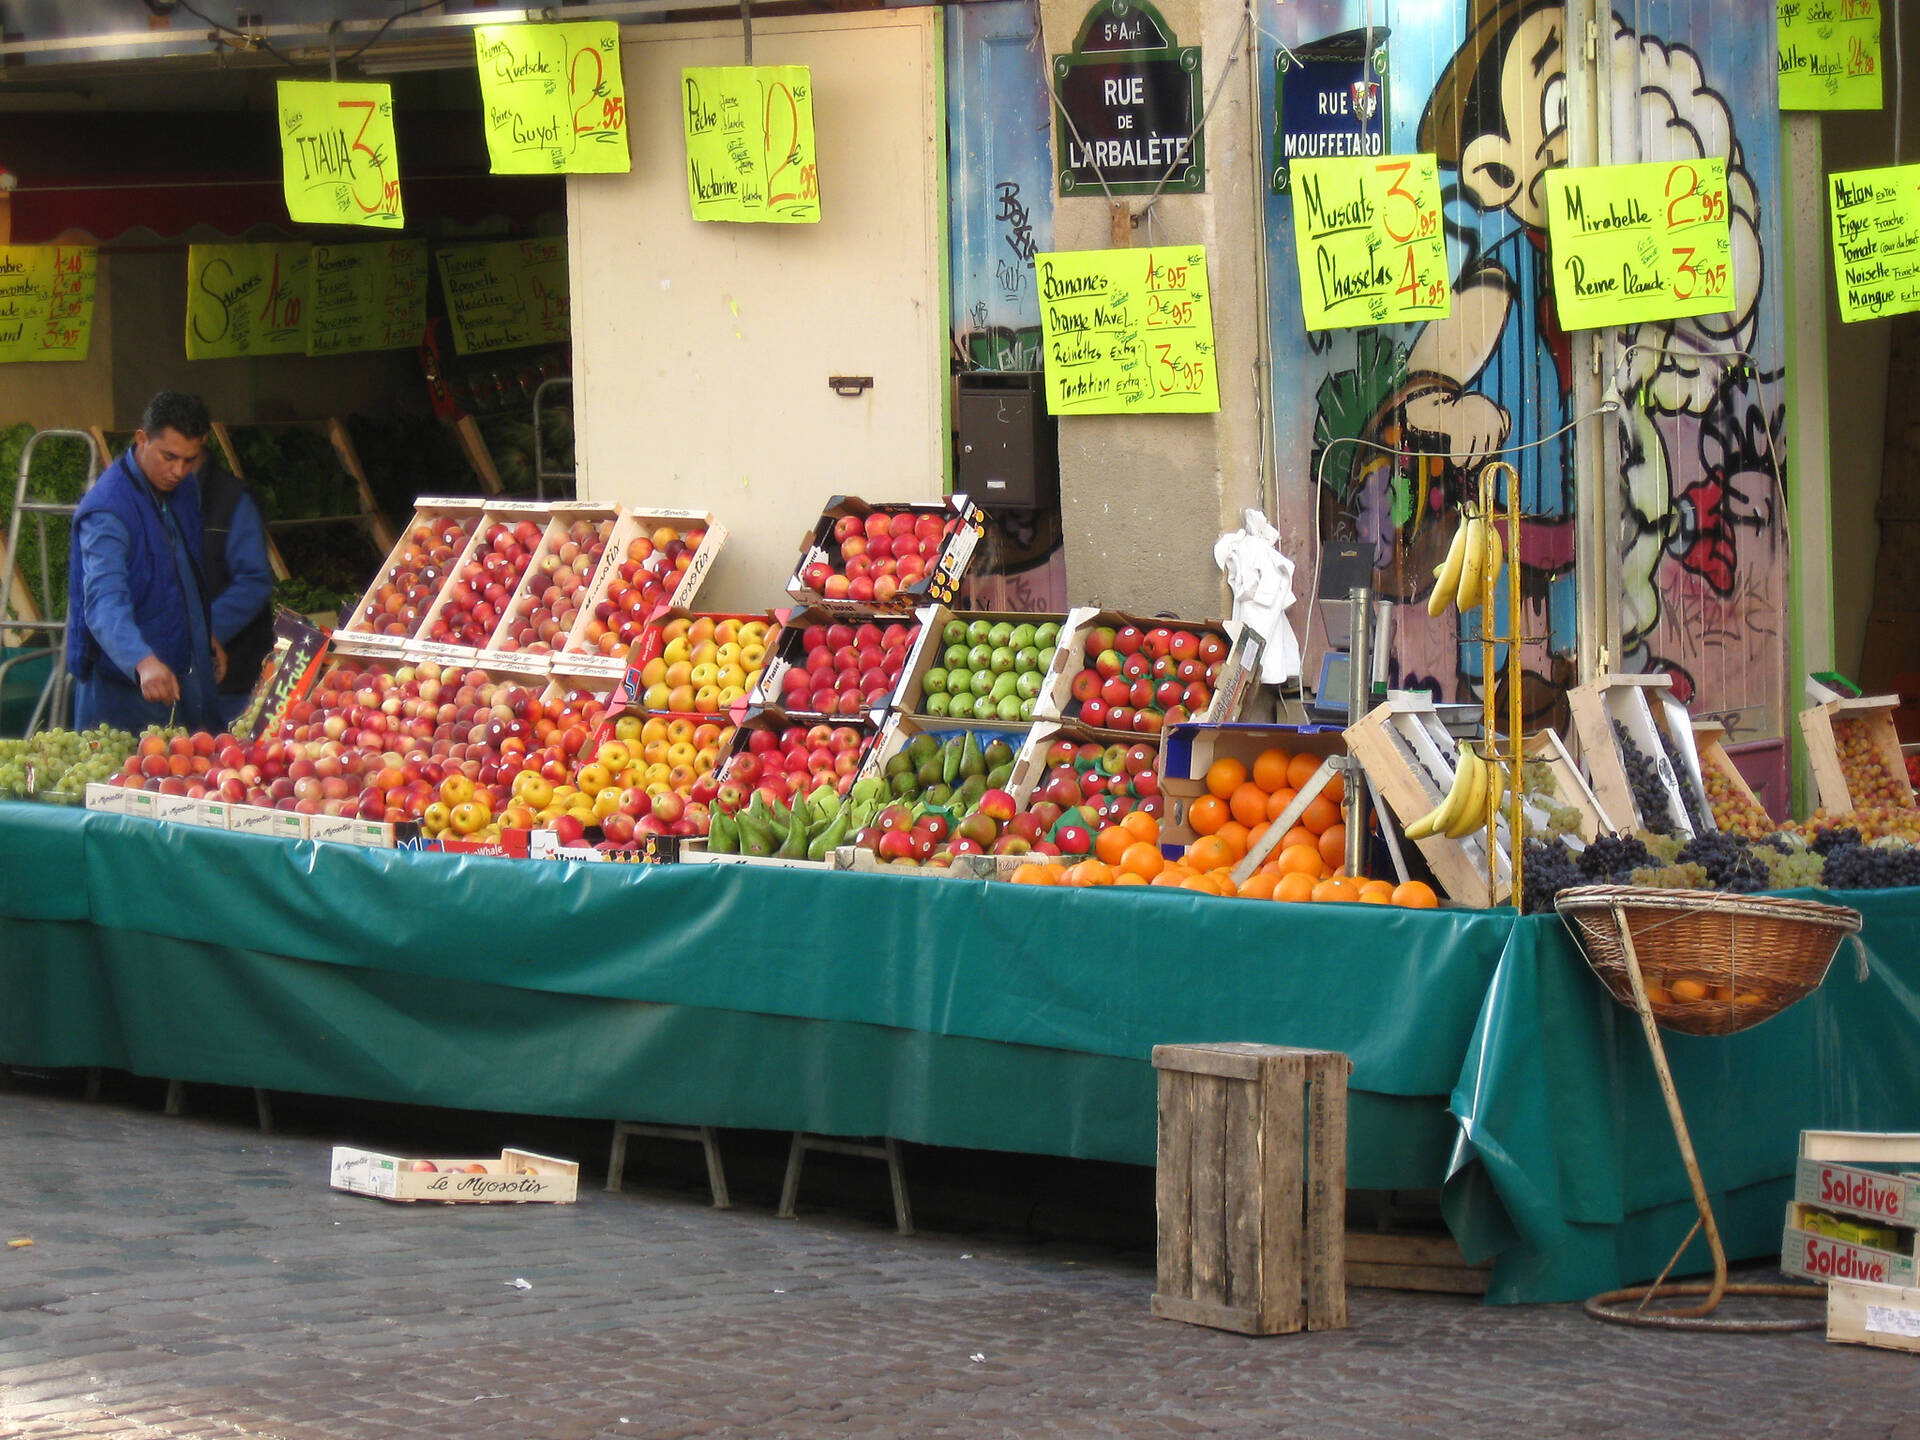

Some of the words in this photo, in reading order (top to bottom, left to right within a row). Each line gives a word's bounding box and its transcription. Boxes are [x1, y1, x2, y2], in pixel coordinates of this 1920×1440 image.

[792, 87, 807, 98] KG
[1104, 78, 1145, 106] RUE
[1318, 92, 1348, 115] RUE
[513, 113, 561, 150] Guyot
[1118, 115, 1133, 129] DE
[296, 128, 357, 181] ITALIA
[1284, 133, 1381, 157] MOUFFETARD
[691, 158, 738, 200] Nectarine
[1302, 173, 1374, 231] Muscats
[1564, 185, 1652, 233] Mirabelle
[1836, 213, 1870, 242] Figue
[1838, 237, 1877, 262] Tomate
[1041, 261, 1108, 299] Bananes
[1317, 244, 1393, 309] Chasselas
[1564, 255, 1619, 296] Reine
[1623, 262, 1665, 295] Claude
[1845, 262, 1890, 285] Noisette
[1848, 289, 1896, 313] Mangue
[1901, 284, 1920, 300] Extr
[1050, 306, 1090, 346] Orange
[426, 1176, 448, 1191] Le
[457, 1176, 549, 1197] Myosotis
[1821, 1168, 1900, 1216] Soldive
[1806, 1239, 1884, 1283] Soldive
